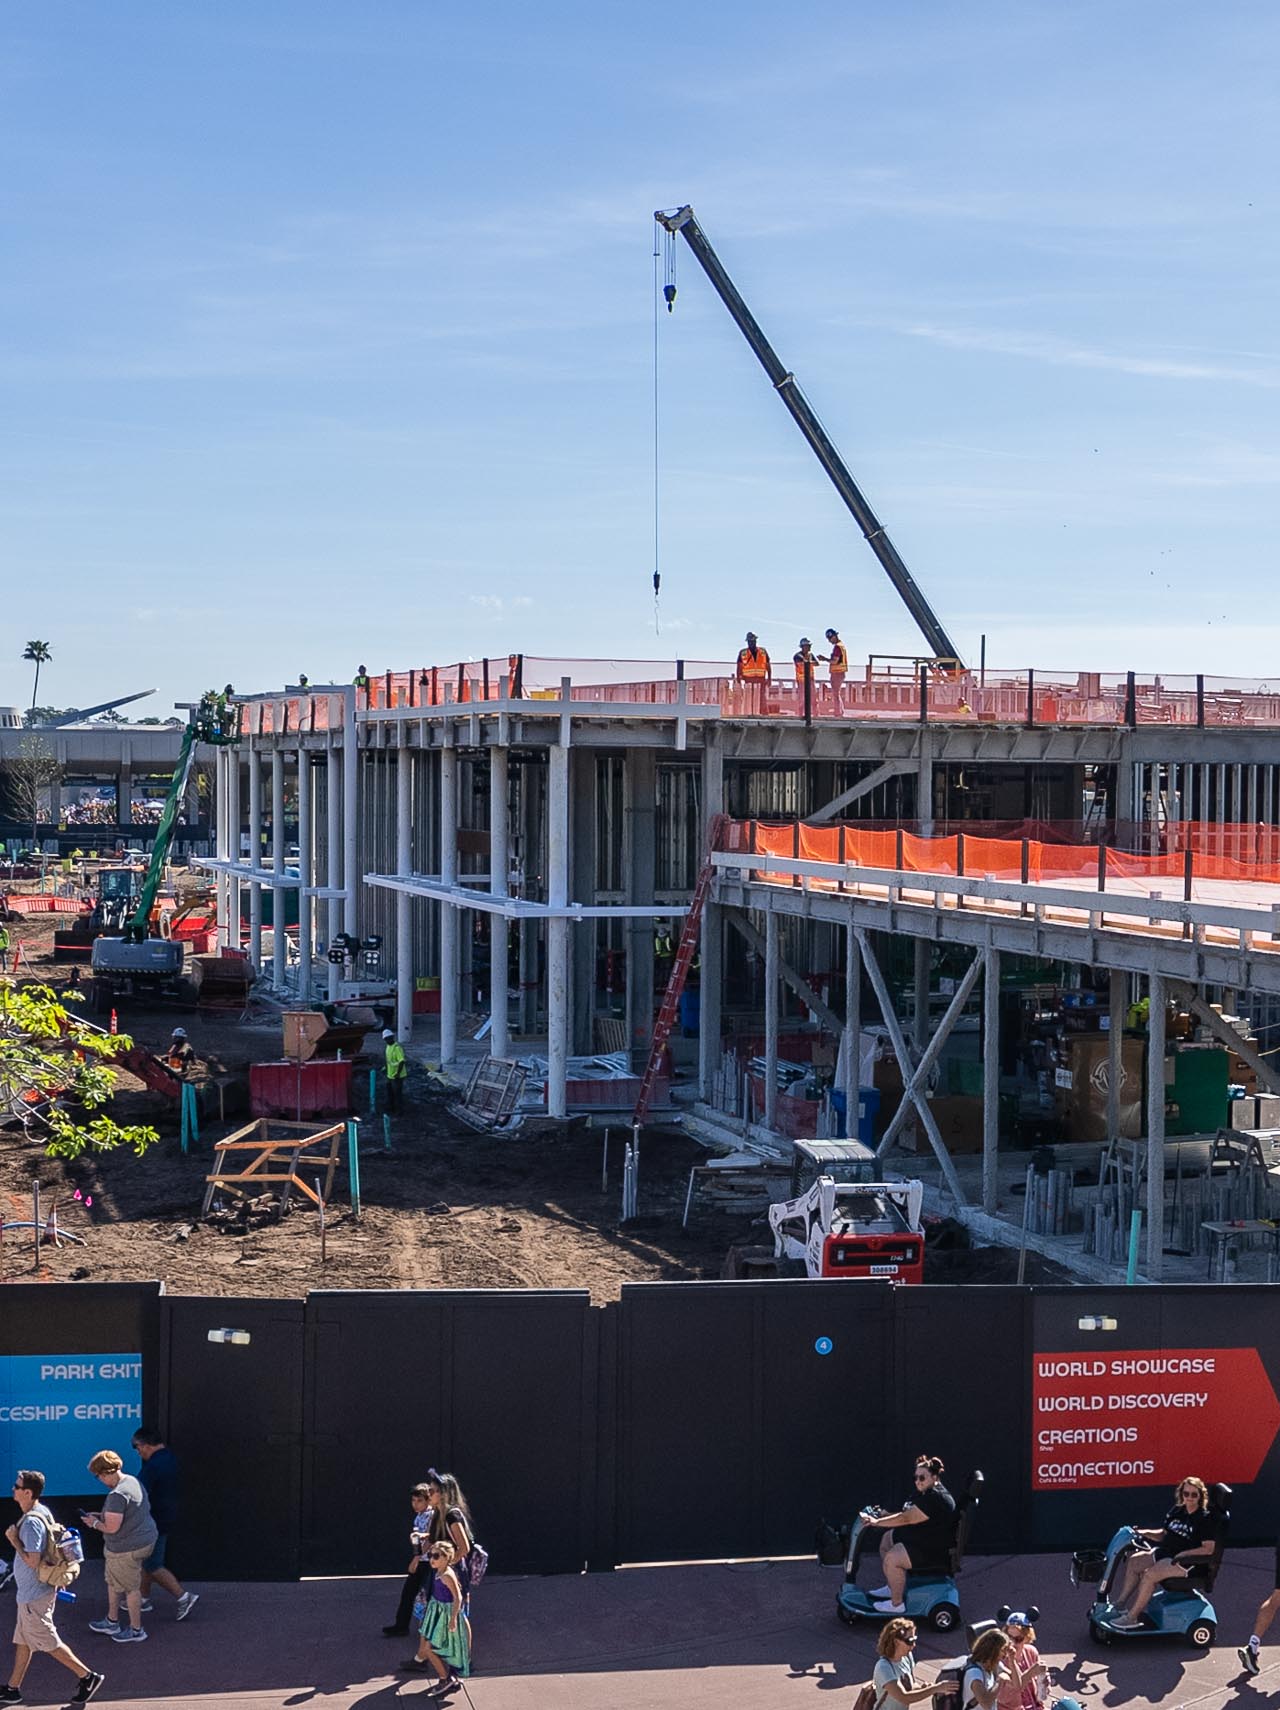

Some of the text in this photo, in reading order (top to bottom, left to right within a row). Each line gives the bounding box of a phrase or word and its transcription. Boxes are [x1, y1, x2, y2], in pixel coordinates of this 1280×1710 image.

[41, 1363, 142, 1380] PARK EXIT
[1038, 1358, 1216, 1378] WORLD SHOWCASE
[1038, 1392, 1209, 1412] WORLD DISCOVERY
[0, 1403, 141, 1422] CESHIP EARTH
[1038, 1427, 1138, 1445] CREATIONS
[1038, 1460, 1155, 1478] CONNECTIONS
